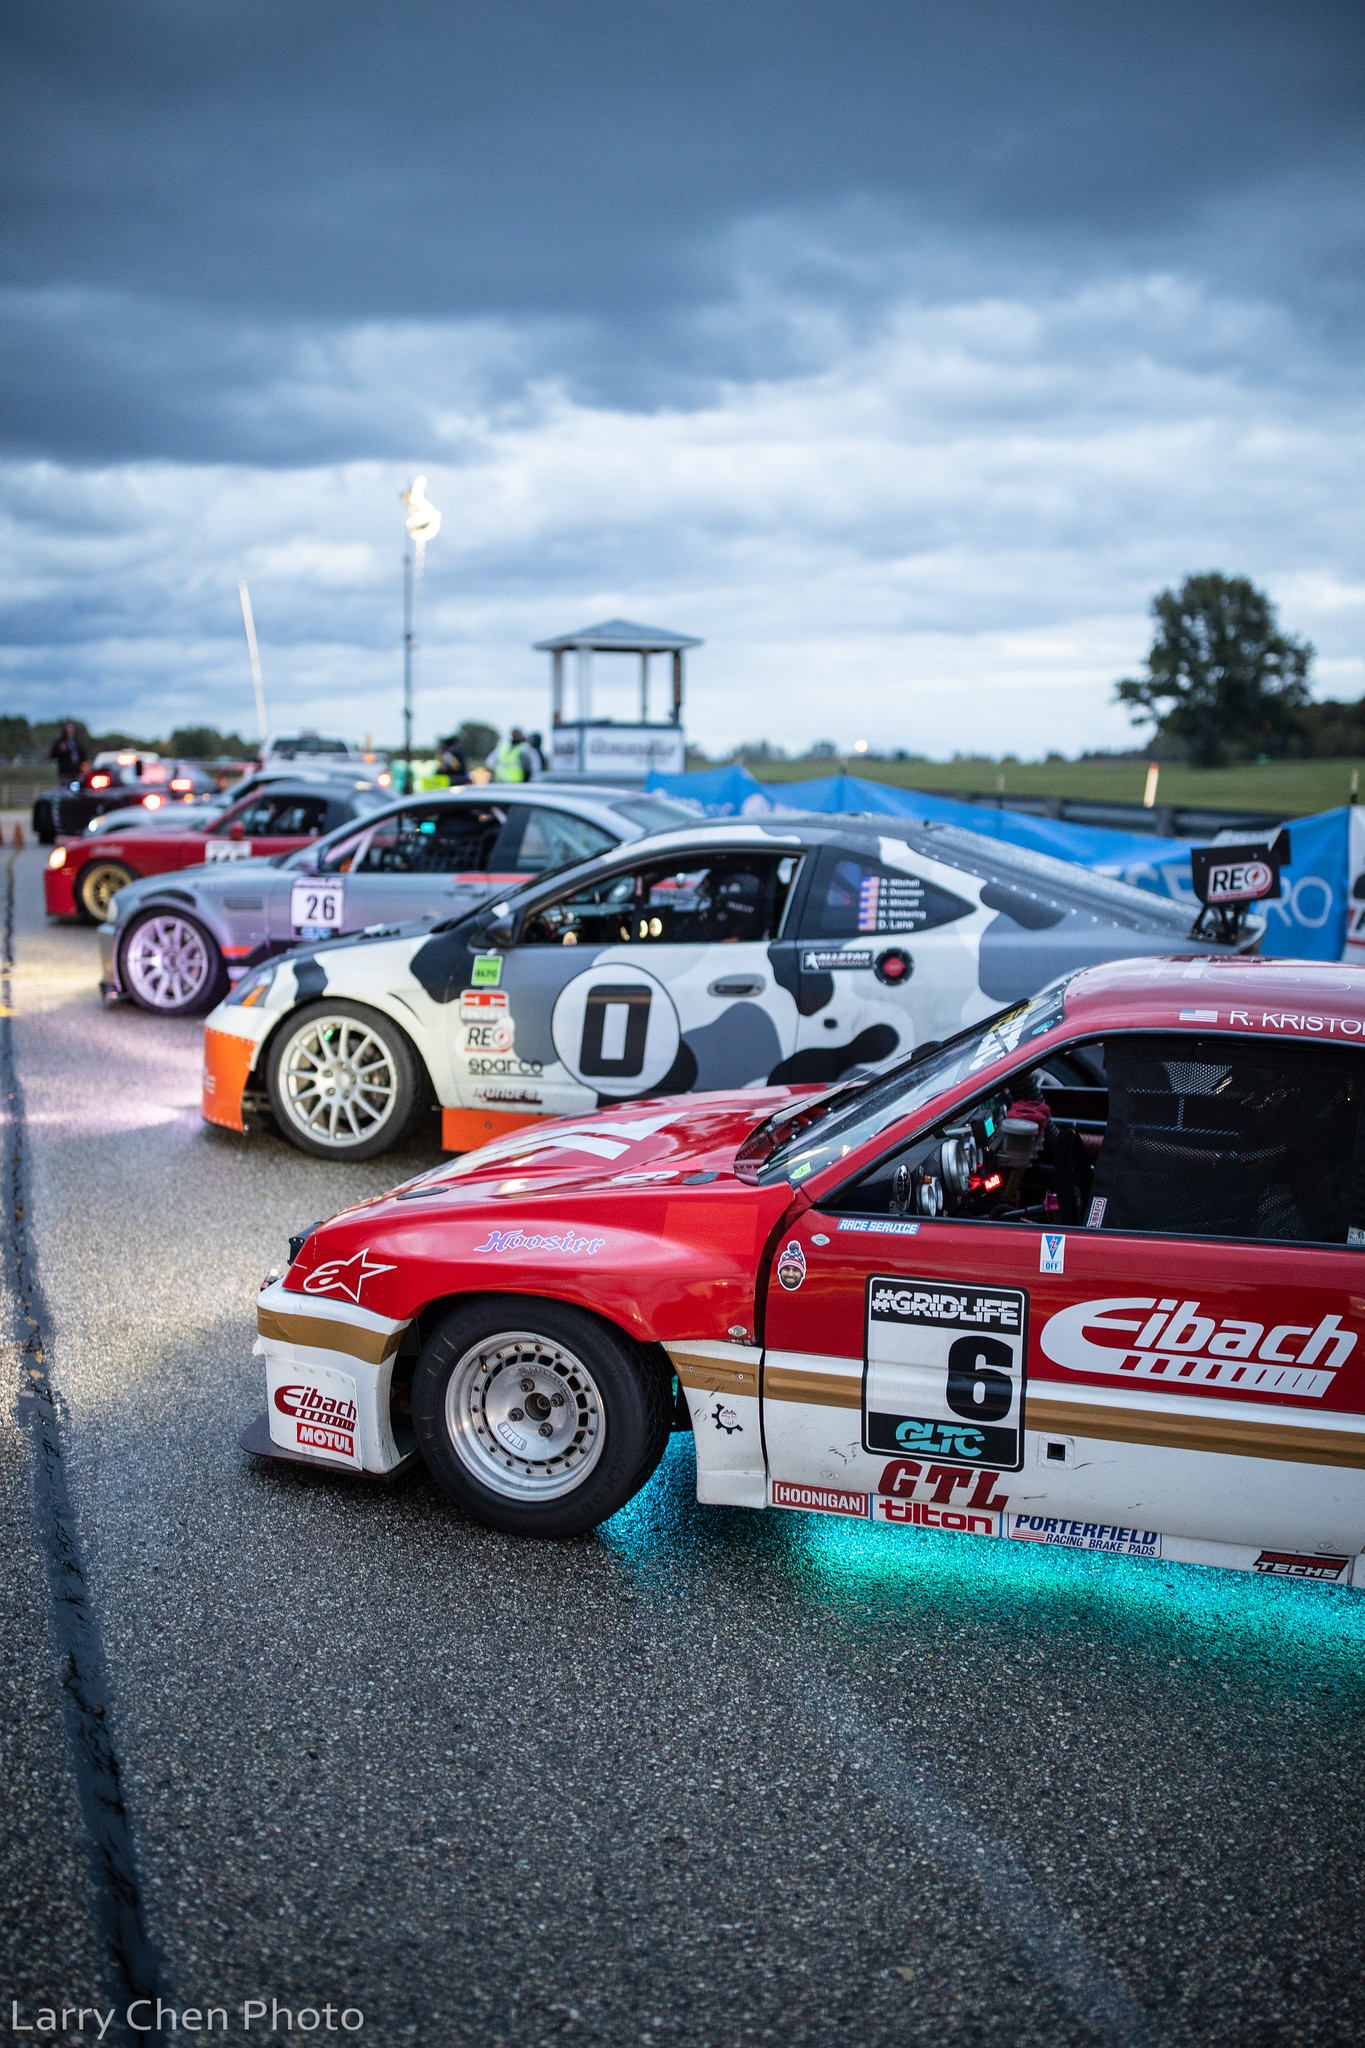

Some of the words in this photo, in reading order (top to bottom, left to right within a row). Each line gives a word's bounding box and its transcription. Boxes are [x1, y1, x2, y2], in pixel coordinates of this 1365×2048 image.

[890, 879, 920, 888] Mitchell
[307, 895, 335, 920] 26
[890, 920, 914, 930] Lane
[818, 952, 871, 961] ALLSTAR
[1229, 1010, 1254, 1026] R.
[1262, 1012, 1365, 1036] KRISTO
[468, 1058, 544, 1076] sparco
[839, 1219, 869, 1231] RACE
[867, 1221, 918, 1235] SERVICE
[473, 1228, 606, 1255] Hoosier
[1045, 1262, 1059, 1271] OFF
[871, 1288, 1020, 1327] #GRIDLIFE
[1040, 1297, 1359, 1397] Eibach
[946, 1335, 1014, 1423] 6
[273, 1384, 357, 1432] Eibach
[299, 1426, 352, 1453] MOTUL
[895, 1420, 986, 1457] GLTC
[877, 1459, 1009, 1512] GTL
[879, 1499, 994, 1535] tilton
[1014, 1514, 1158, 1546] PORTERFIELD
[1045, 1533, 1084, 1547] RACING
[1088, 1539, 1124, 1553] BRAKE
[1127, 1544, 1156, 1556] PADS
[1257, 1561, 1340, 1579] TECHS
[1260, 1552, 1346, 1569] HORSEPOWER
